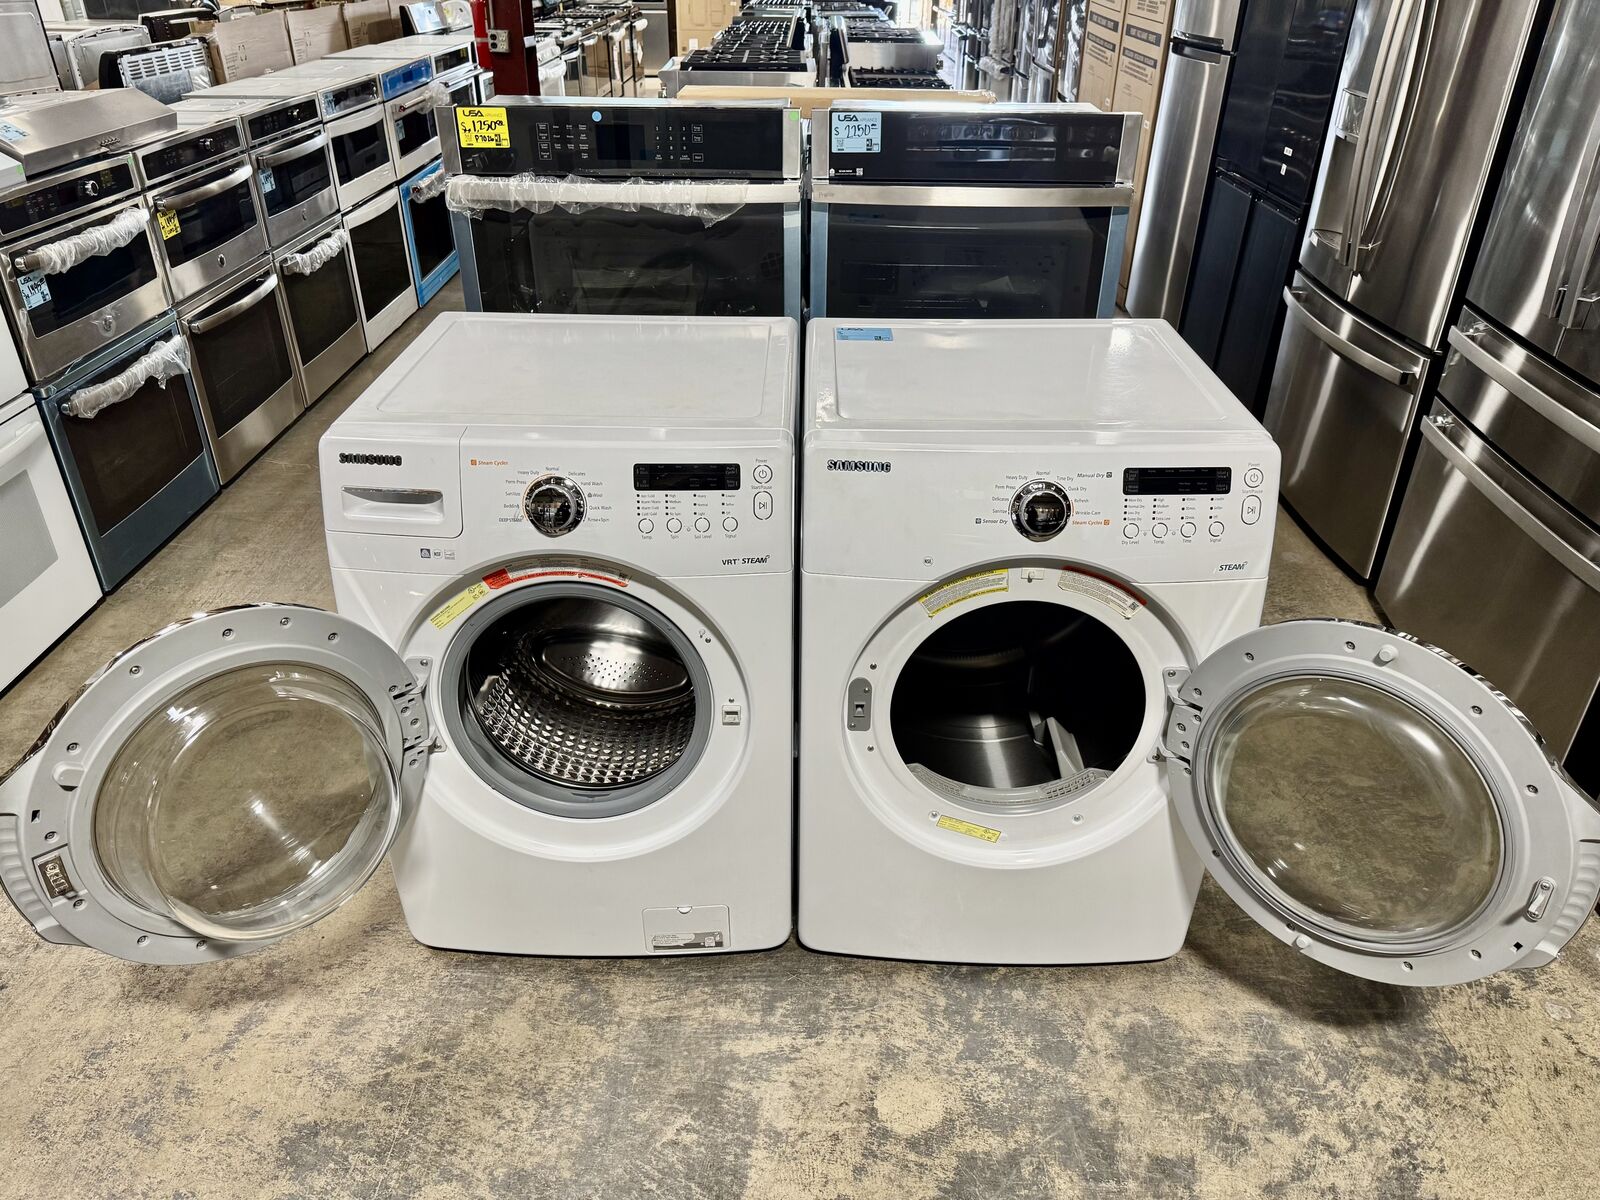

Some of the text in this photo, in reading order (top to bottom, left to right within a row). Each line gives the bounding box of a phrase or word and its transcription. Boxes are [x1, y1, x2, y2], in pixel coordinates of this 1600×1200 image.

[462, 110, 484, 118] USA
[838, 114, 859, 122] USA
[339, 453, 402, 466] SAMSUNG
[827, 459, 892, 473] SAMSUNG
[742, 556, 769, 565] STEAM
[1219, 563, 1246, 571] STEAM
